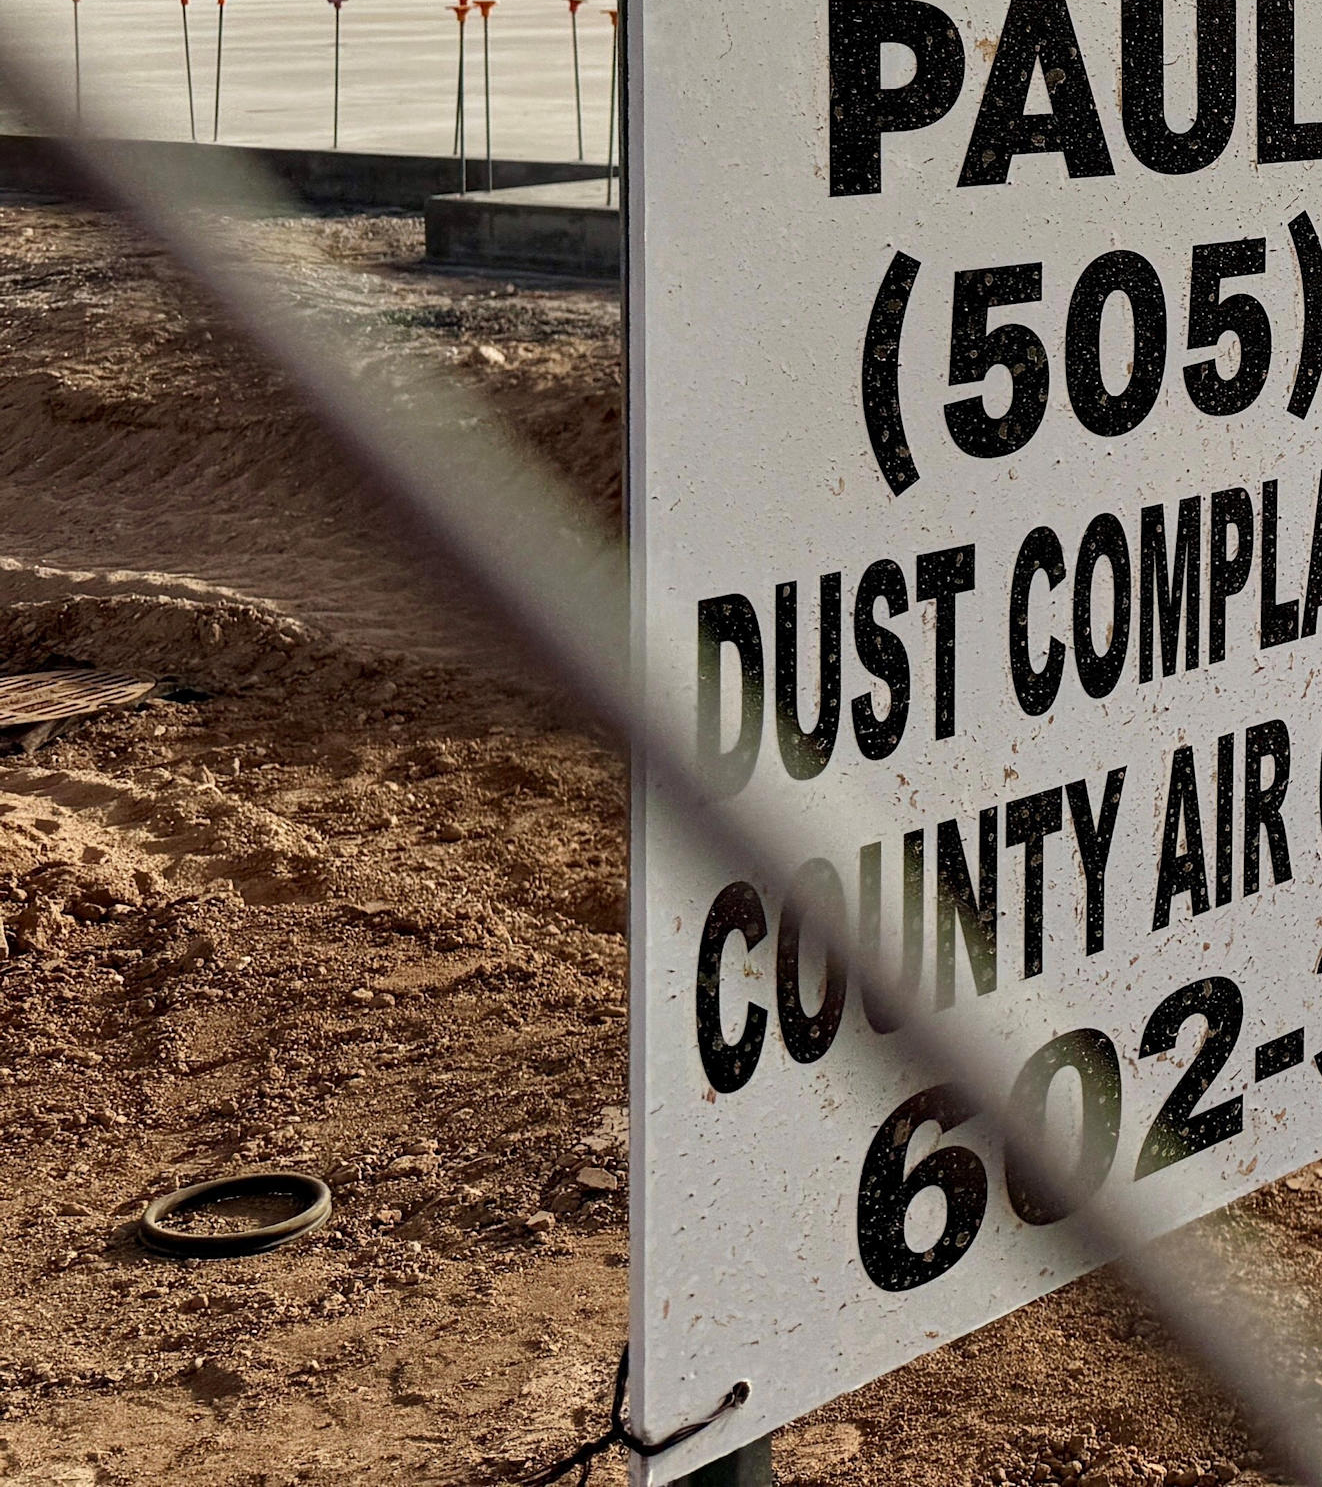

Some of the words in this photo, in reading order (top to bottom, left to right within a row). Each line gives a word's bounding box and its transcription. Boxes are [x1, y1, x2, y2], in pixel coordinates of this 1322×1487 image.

[697, 544, 976, 799] DUST
[696, 765, 1126, 1094] COUNTY
[1150, 717, 1292, 933] AIR
